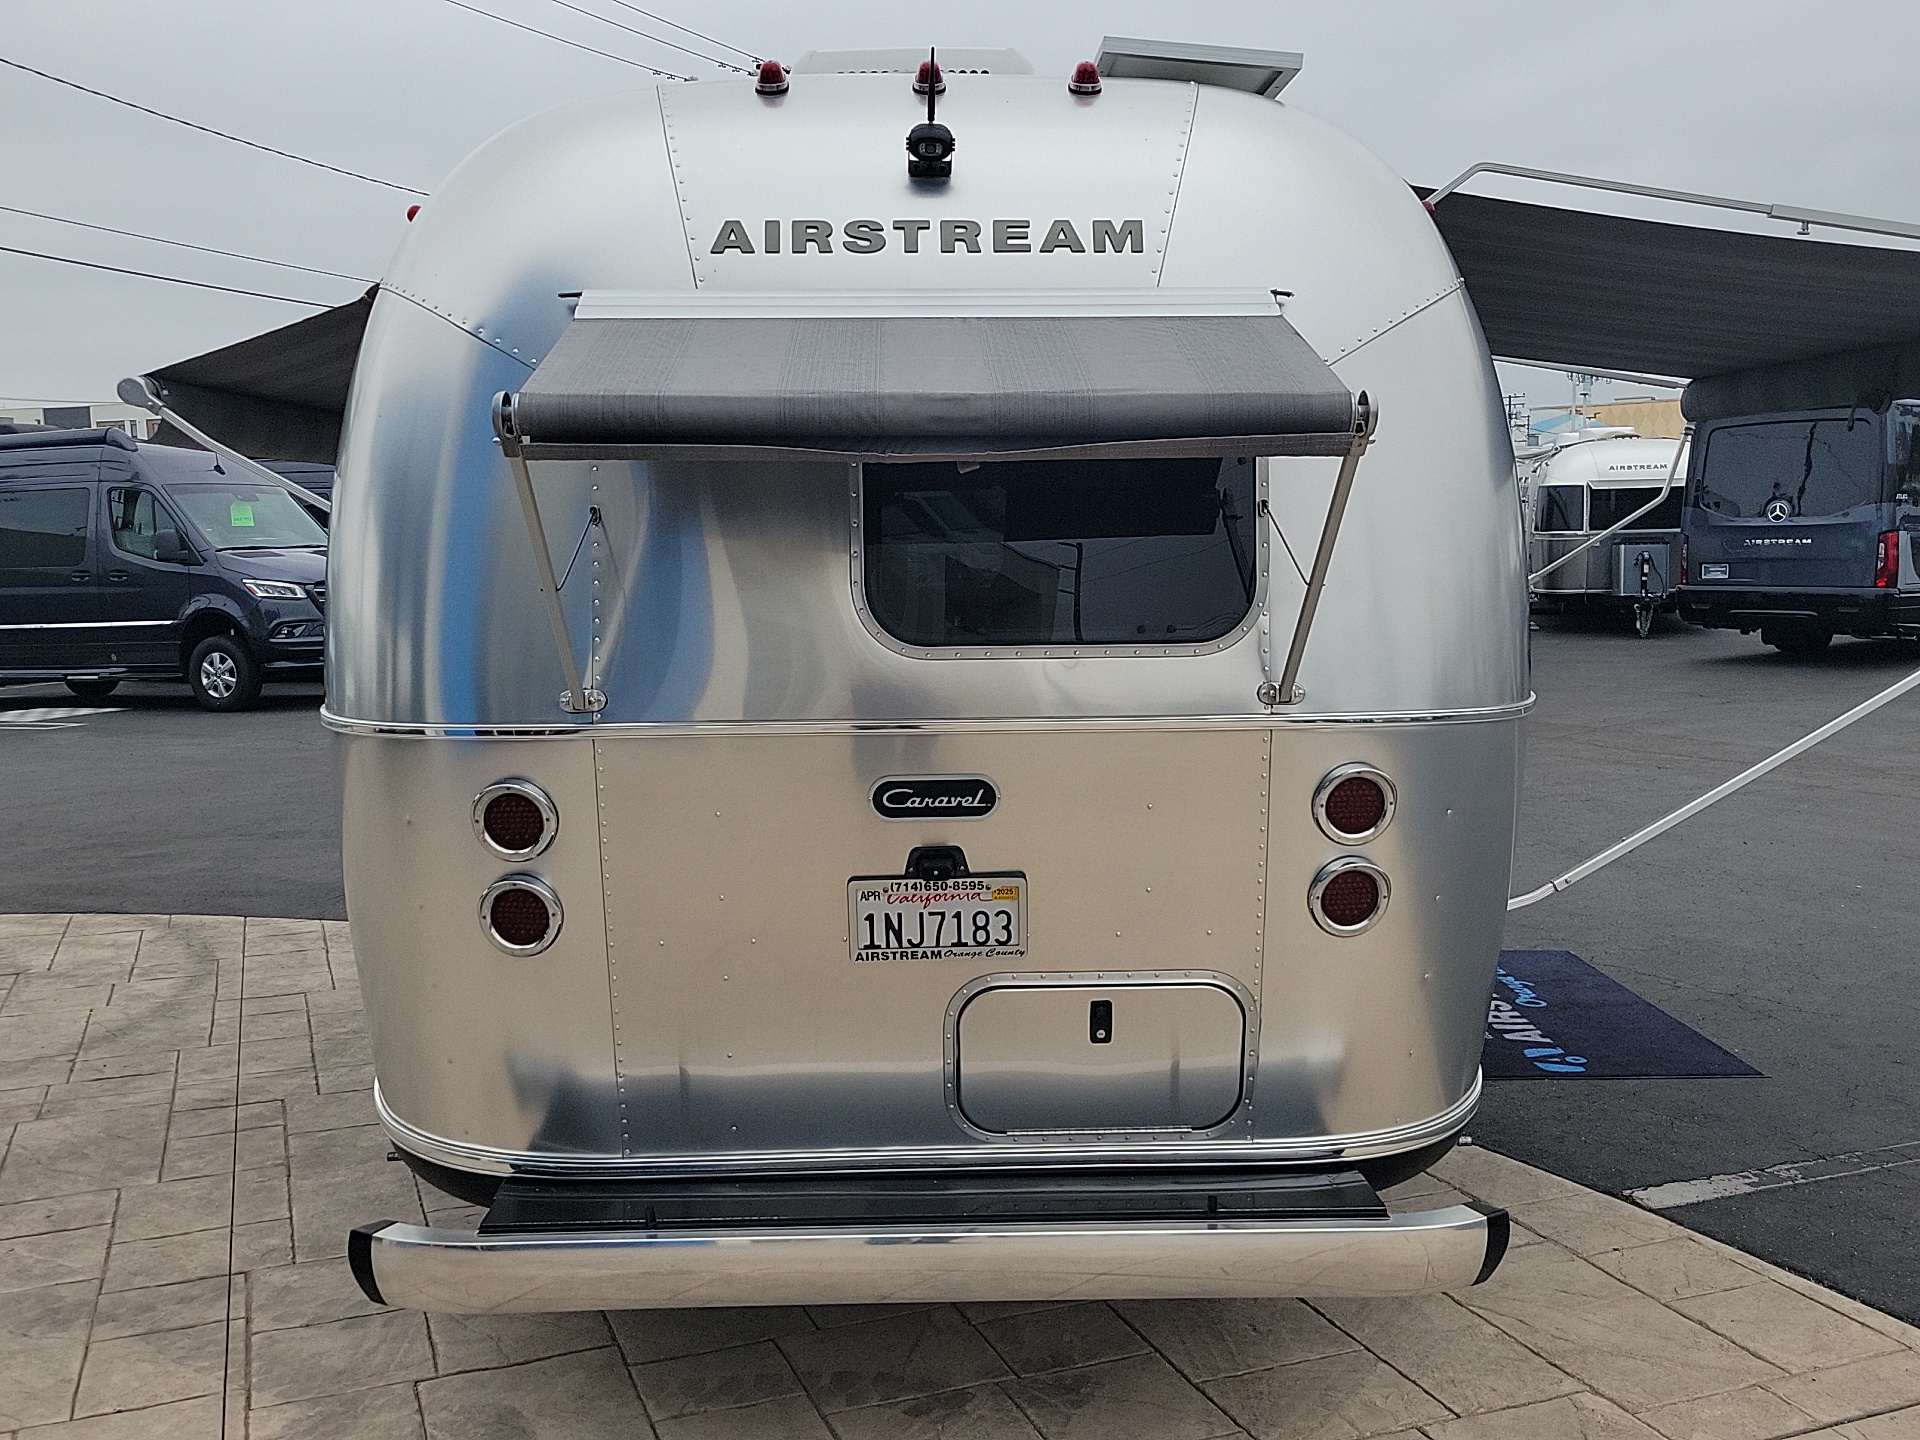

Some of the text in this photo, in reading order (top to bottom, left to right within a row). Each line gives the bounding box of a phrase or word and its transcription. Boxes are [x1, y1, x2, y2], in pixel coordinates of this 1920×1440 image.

[710, 219, 1145, 255] AIRSTREAM
[1608, 463, 1668, 471] AIRSTREAM
[1743, 538, 1812, 546] AIRSTREAM
[883, 788, 991, 808] Caravel
[890, 881, 985, 892] (714)650-8595
[860, 890, 881, 902] APR
[886, 892, 992, 909] California
[863, 909, 1013, 949] 1NJ7183
[855, 948, 1026, 962] AIRSTREAM Orange County
